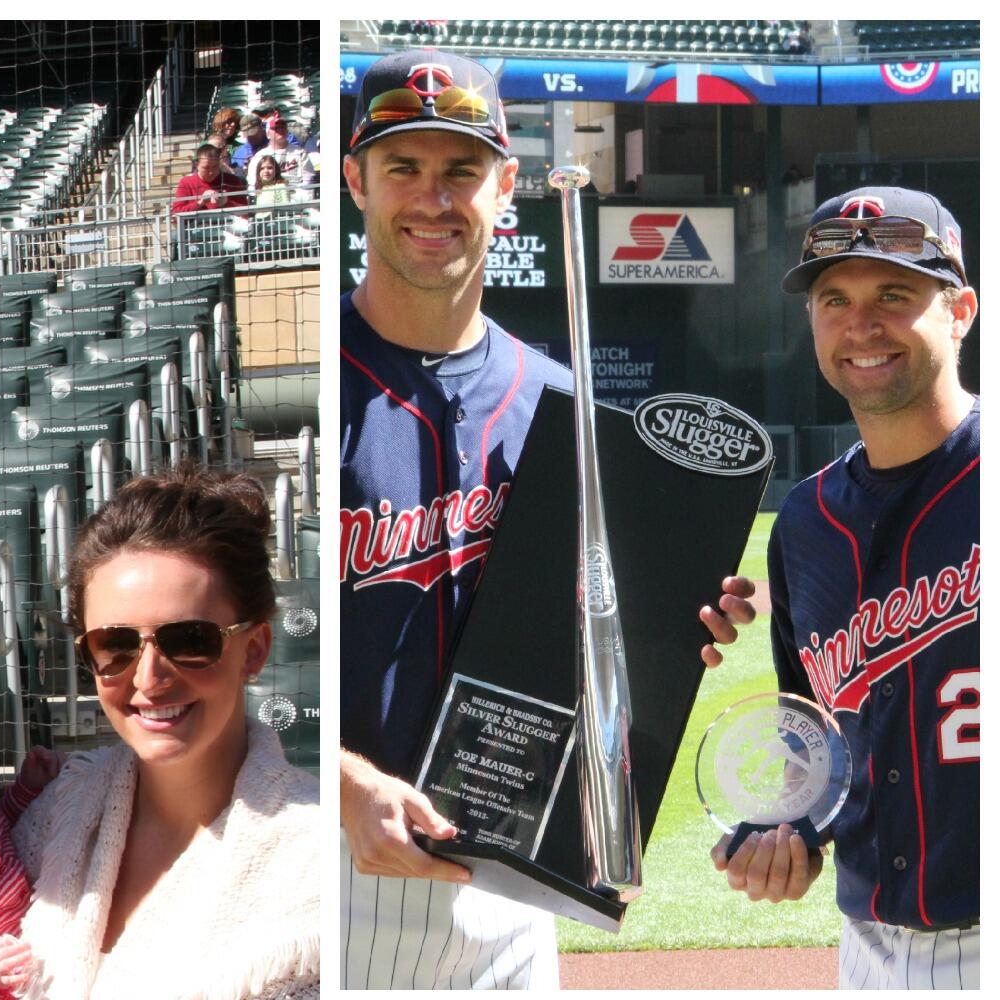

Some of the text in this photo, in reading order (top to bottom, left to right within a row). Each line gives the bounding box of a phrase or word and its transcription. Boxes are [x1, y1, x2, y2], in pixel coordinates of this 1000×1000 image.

[591, 347, 629, 360] ATCH
[591, 362, 654, 376] TONIGHT
[652, 409, 755, 461] Slugger
[682, 410, 753, 441] LOUISVILLE
[457, 702, 557, 743] SILVER SLUGGER
[481, 723, 528, 745] AWARD
[782, 712, 823, 751] PLAYER
[454, 750, 478, 763] JOE
[456, 762, 525, 790] Minnesota Twins
[429, 783, 461, 798] American
[462, 792, 485, 806] League
[459, 782, 487, 796] Member
